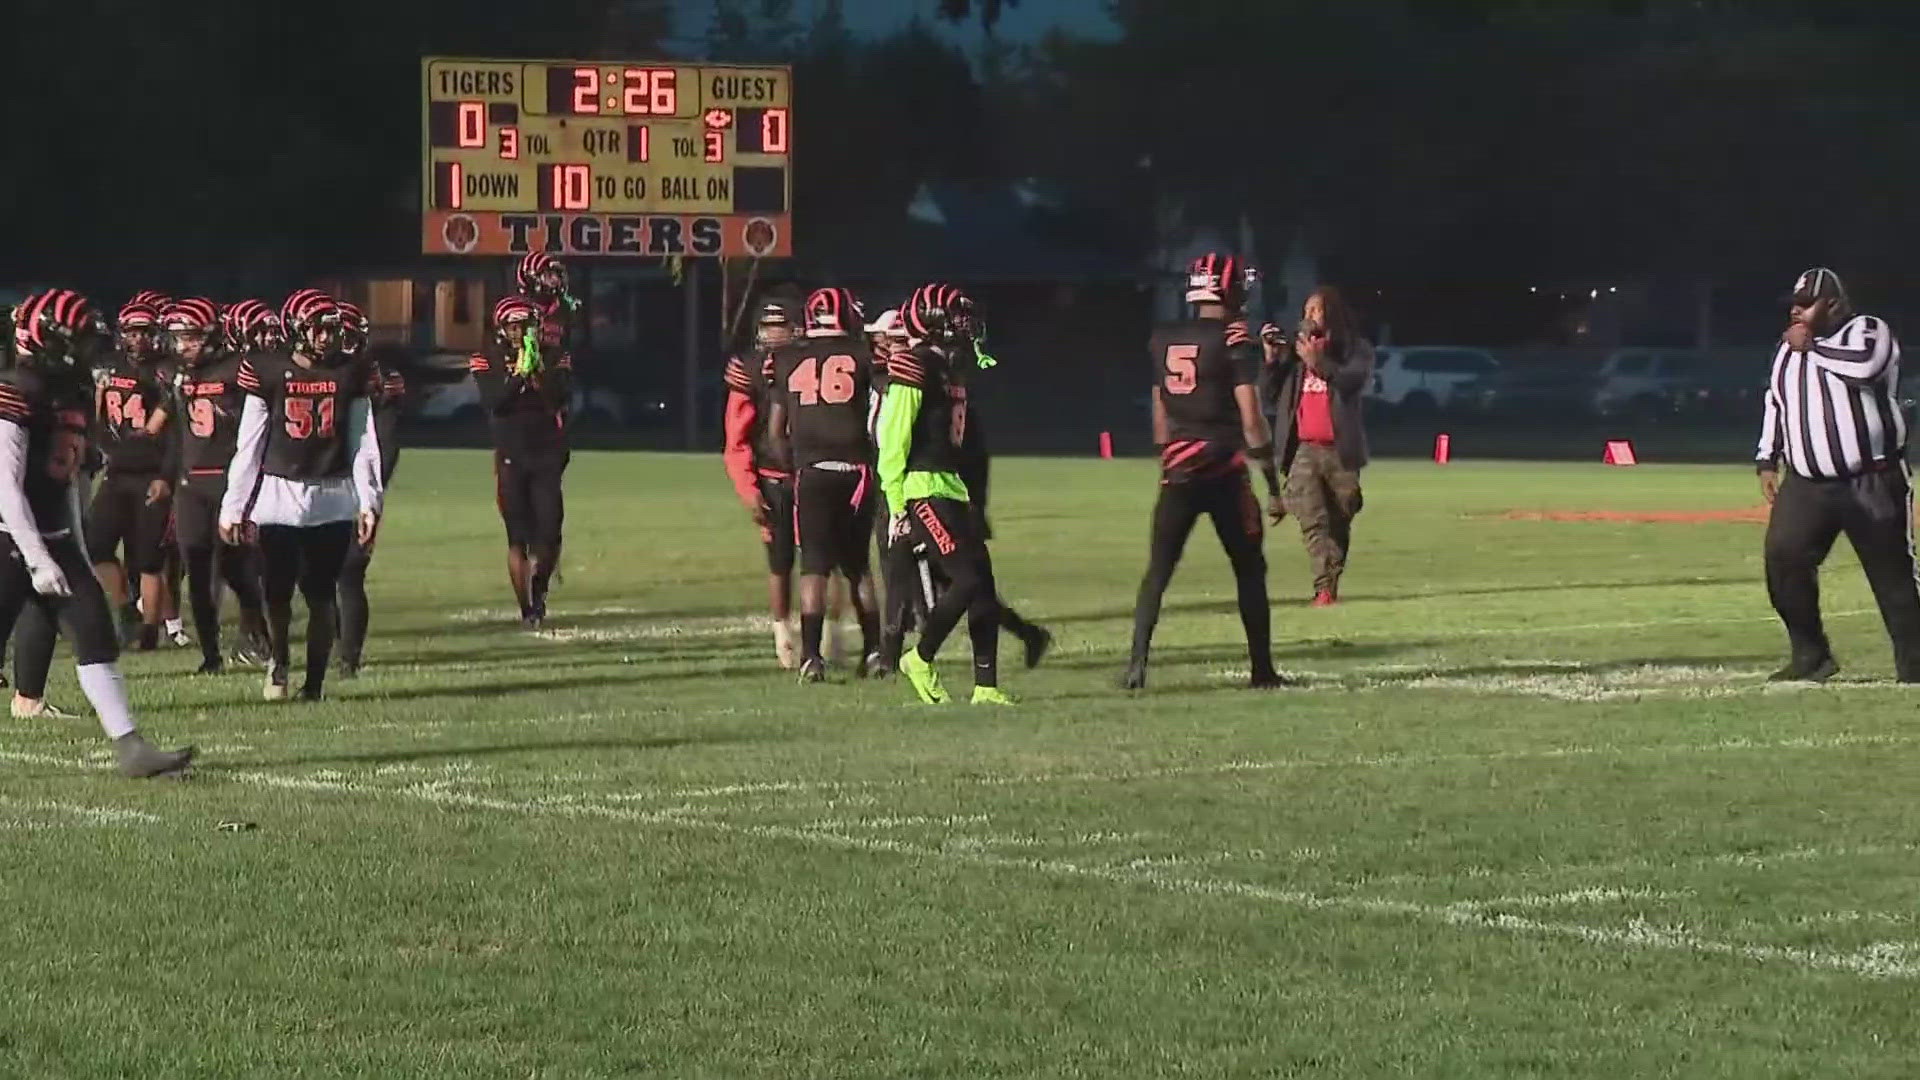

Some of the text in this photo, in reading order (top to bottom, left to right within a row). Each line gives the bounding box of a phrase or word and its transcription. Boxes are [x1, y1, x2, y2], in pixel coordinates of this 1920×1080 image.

[440, 71, 514, 94] TIGERS
[574, 68, 676, 114] 2:26
[712, 77, 777, 101] GUEST
[459, 101, 485, 147] 0
[500, 128, 550, 158] 3 TOL
[583, 130, 620, 155] QTR
[762, 109, 787, 152] 0
[673, 132, 722, 162] TOL 3
[452, 163, 518, 208] 1 DOWN
[554, 165, 646, 209] 10 TO GO
[661, 177, 729, 201] BALL ON
[501, 215, 722, 254] TIGERS
[788, 355, 856, 405] 46
[1165, 344, 1199, 394] 5
[187, 398, 214, 437] 9
[285, 397, 335, 439] 51
